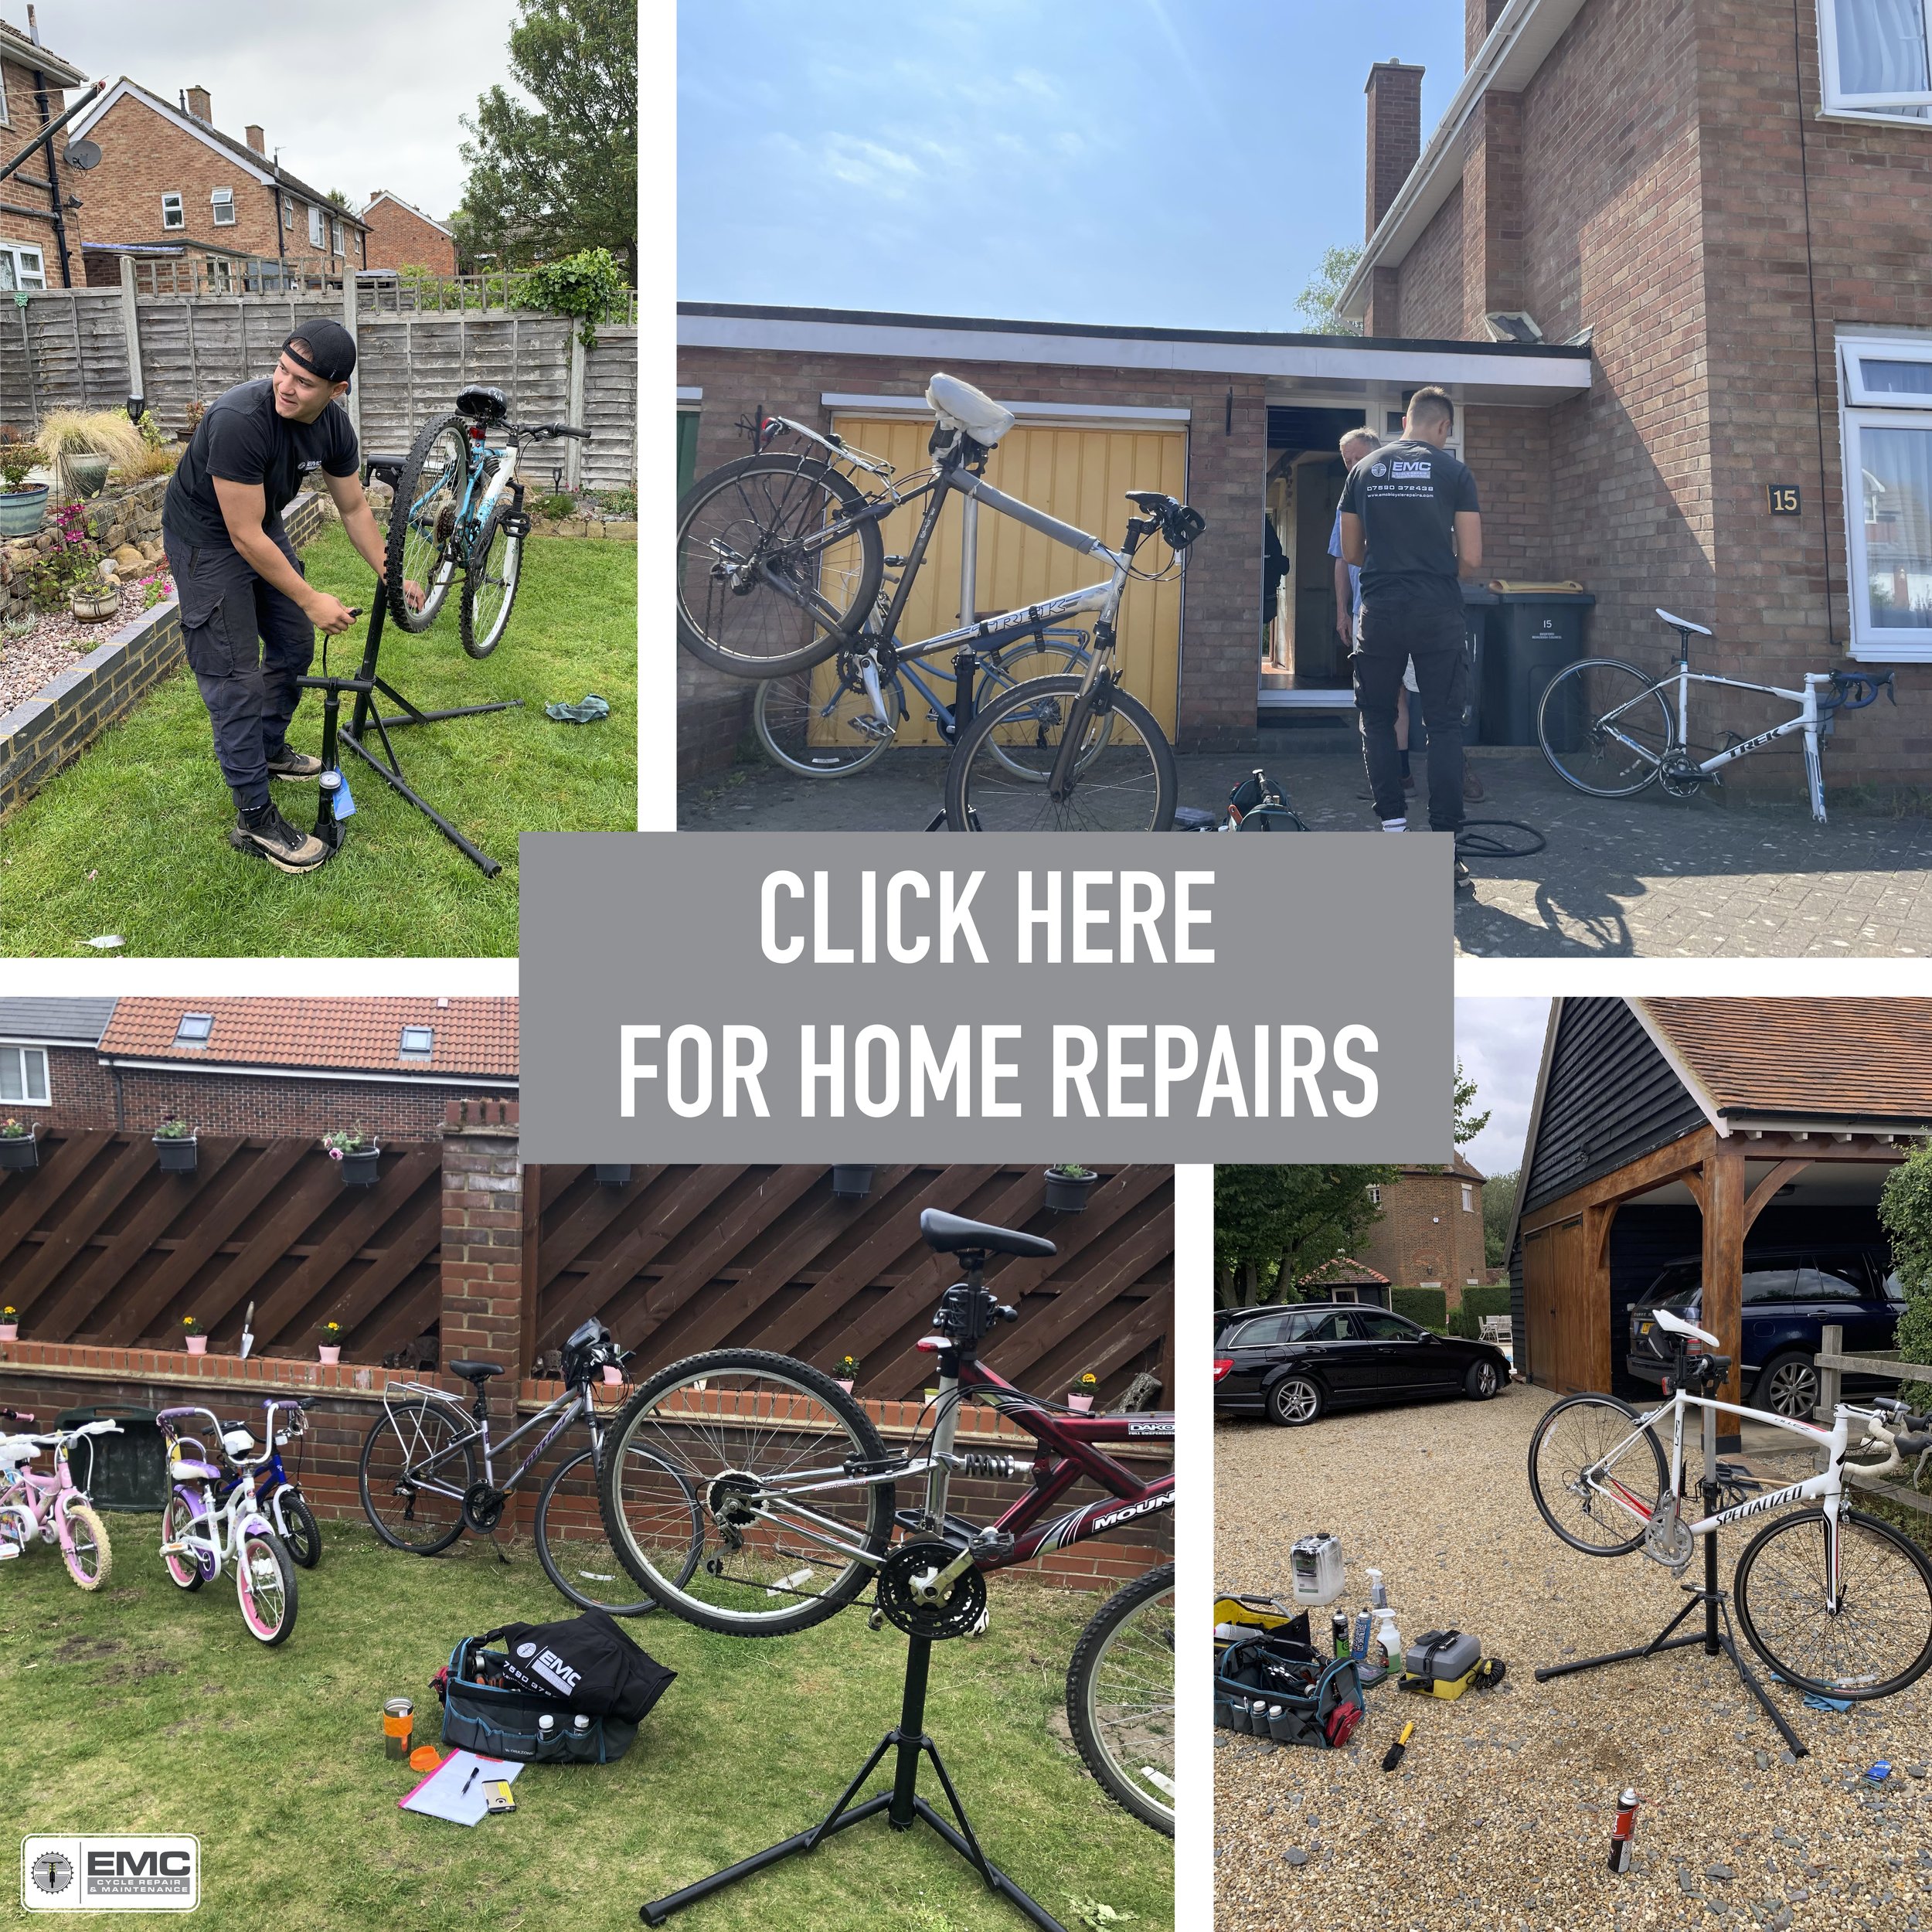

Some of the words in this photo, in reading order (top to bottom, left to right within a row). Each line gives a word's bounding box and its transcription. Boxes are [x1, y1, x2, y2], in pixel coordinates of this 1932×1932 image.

[1393, 461, 1432, 471] EMC
[1774, 489, 1798, 511] 15
[972, 599, 1066, 638] TREK
[1543, 620, 1553, 628] 15
[1725, 728, 1782, 758] TREK
[1129, 1423, 1175, 1432] DAKO
[1094, 1492, 1175, 1530] MOUN
[1715, 1485, 1803, 1528] SPECIALIZED
[539, 1649, 582, 1688] EMC
[531, 1682, 557, 1698] 372
